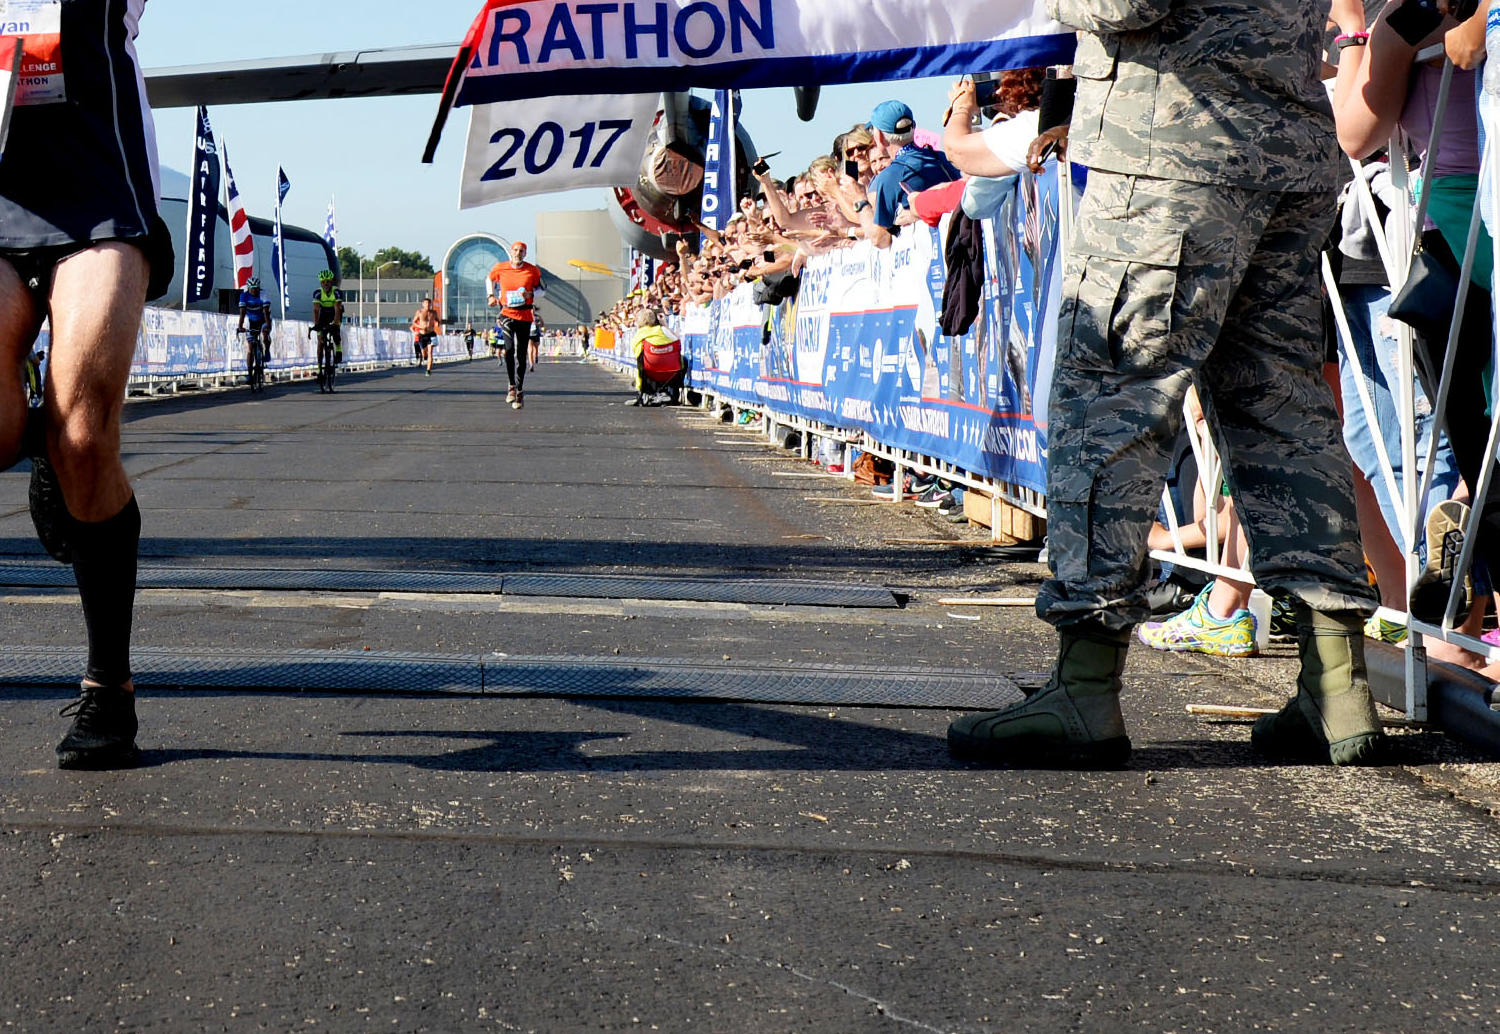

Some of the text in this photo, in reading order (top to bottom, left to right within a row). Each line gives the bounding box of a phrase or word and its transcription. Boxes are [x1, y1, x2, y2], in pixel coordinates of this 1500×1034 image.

[19, 62, 57, 73] LENGE
[16, 77, 49, 87] THON
[480, 119, 633, 182] 2017
